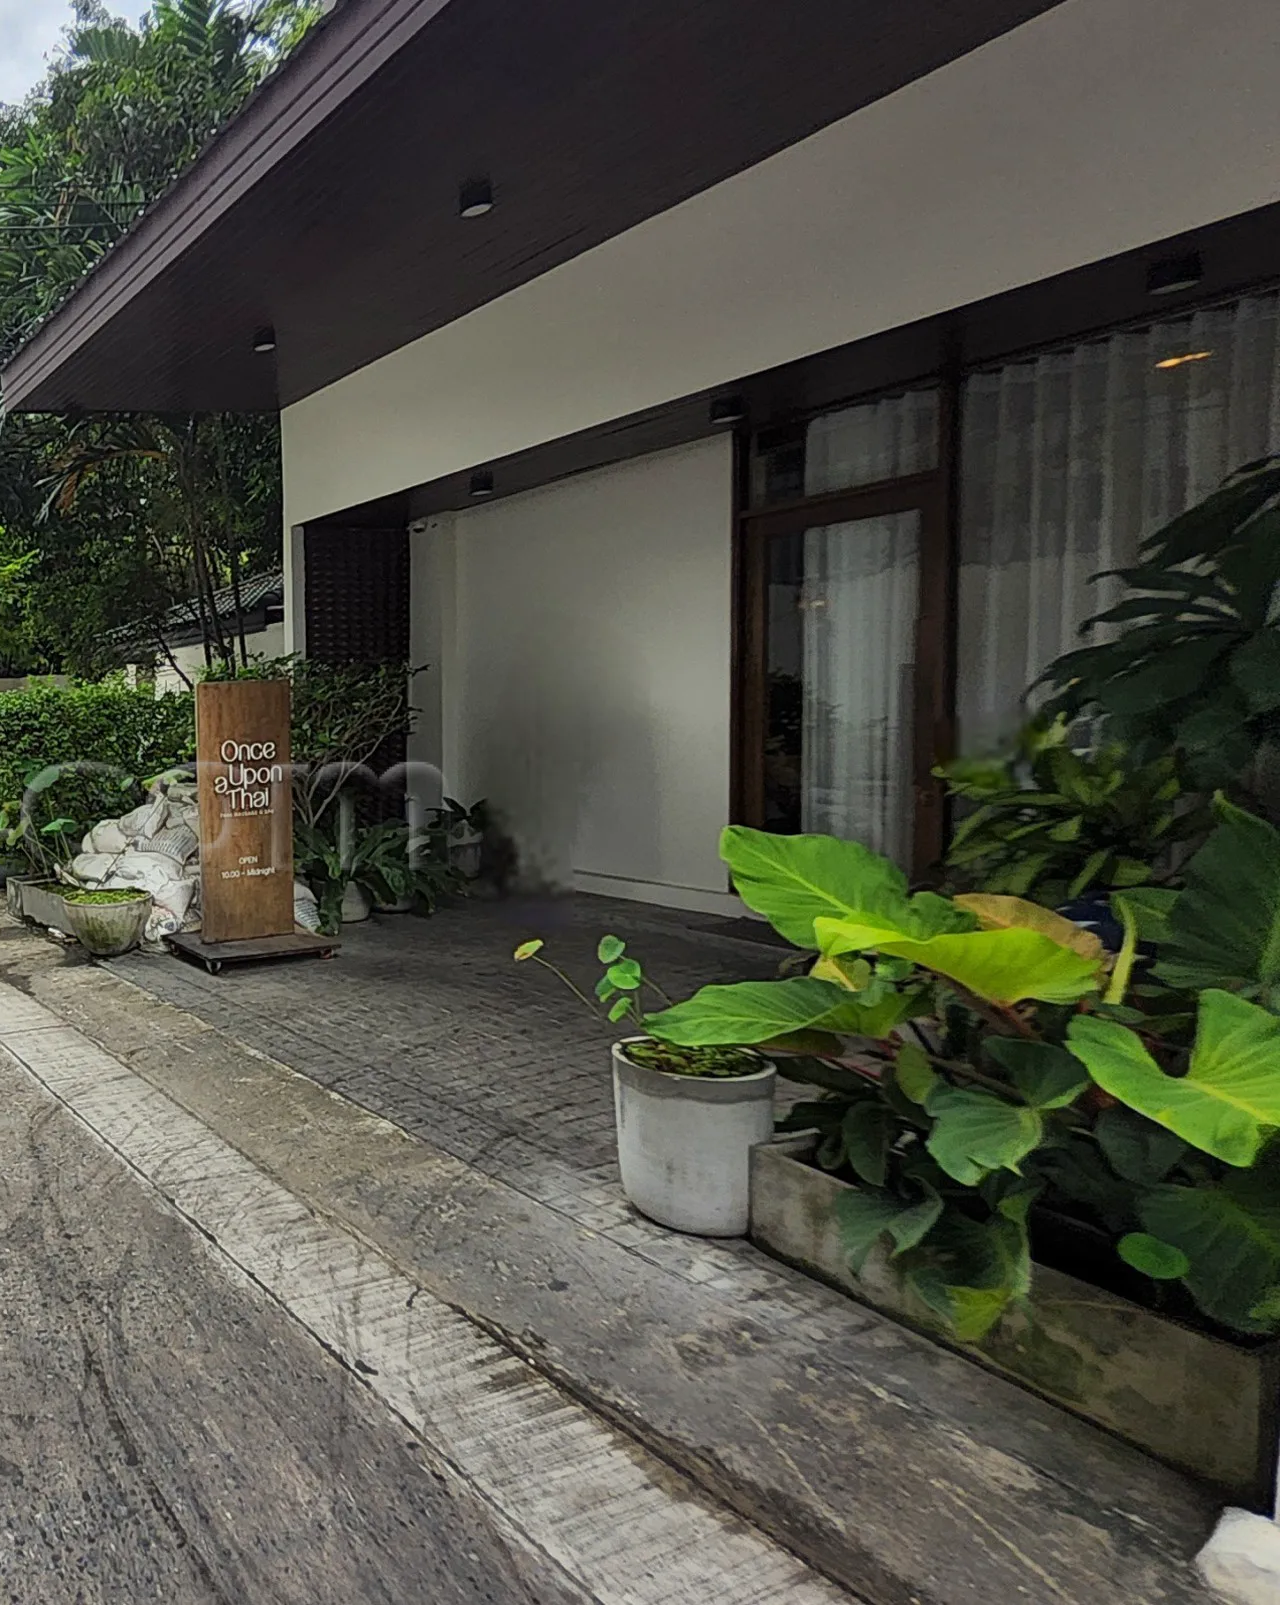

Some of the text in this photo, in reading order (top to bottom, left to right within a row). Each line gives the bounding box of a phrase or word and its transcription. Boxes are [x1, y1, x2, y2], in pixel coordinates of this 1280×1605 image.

[221, 740, 276, 763] Once
[228, 763, 282, 790] Upon
[214, 776, 269, 810] a Thai
[238, 855, 258, 864] OPEN
